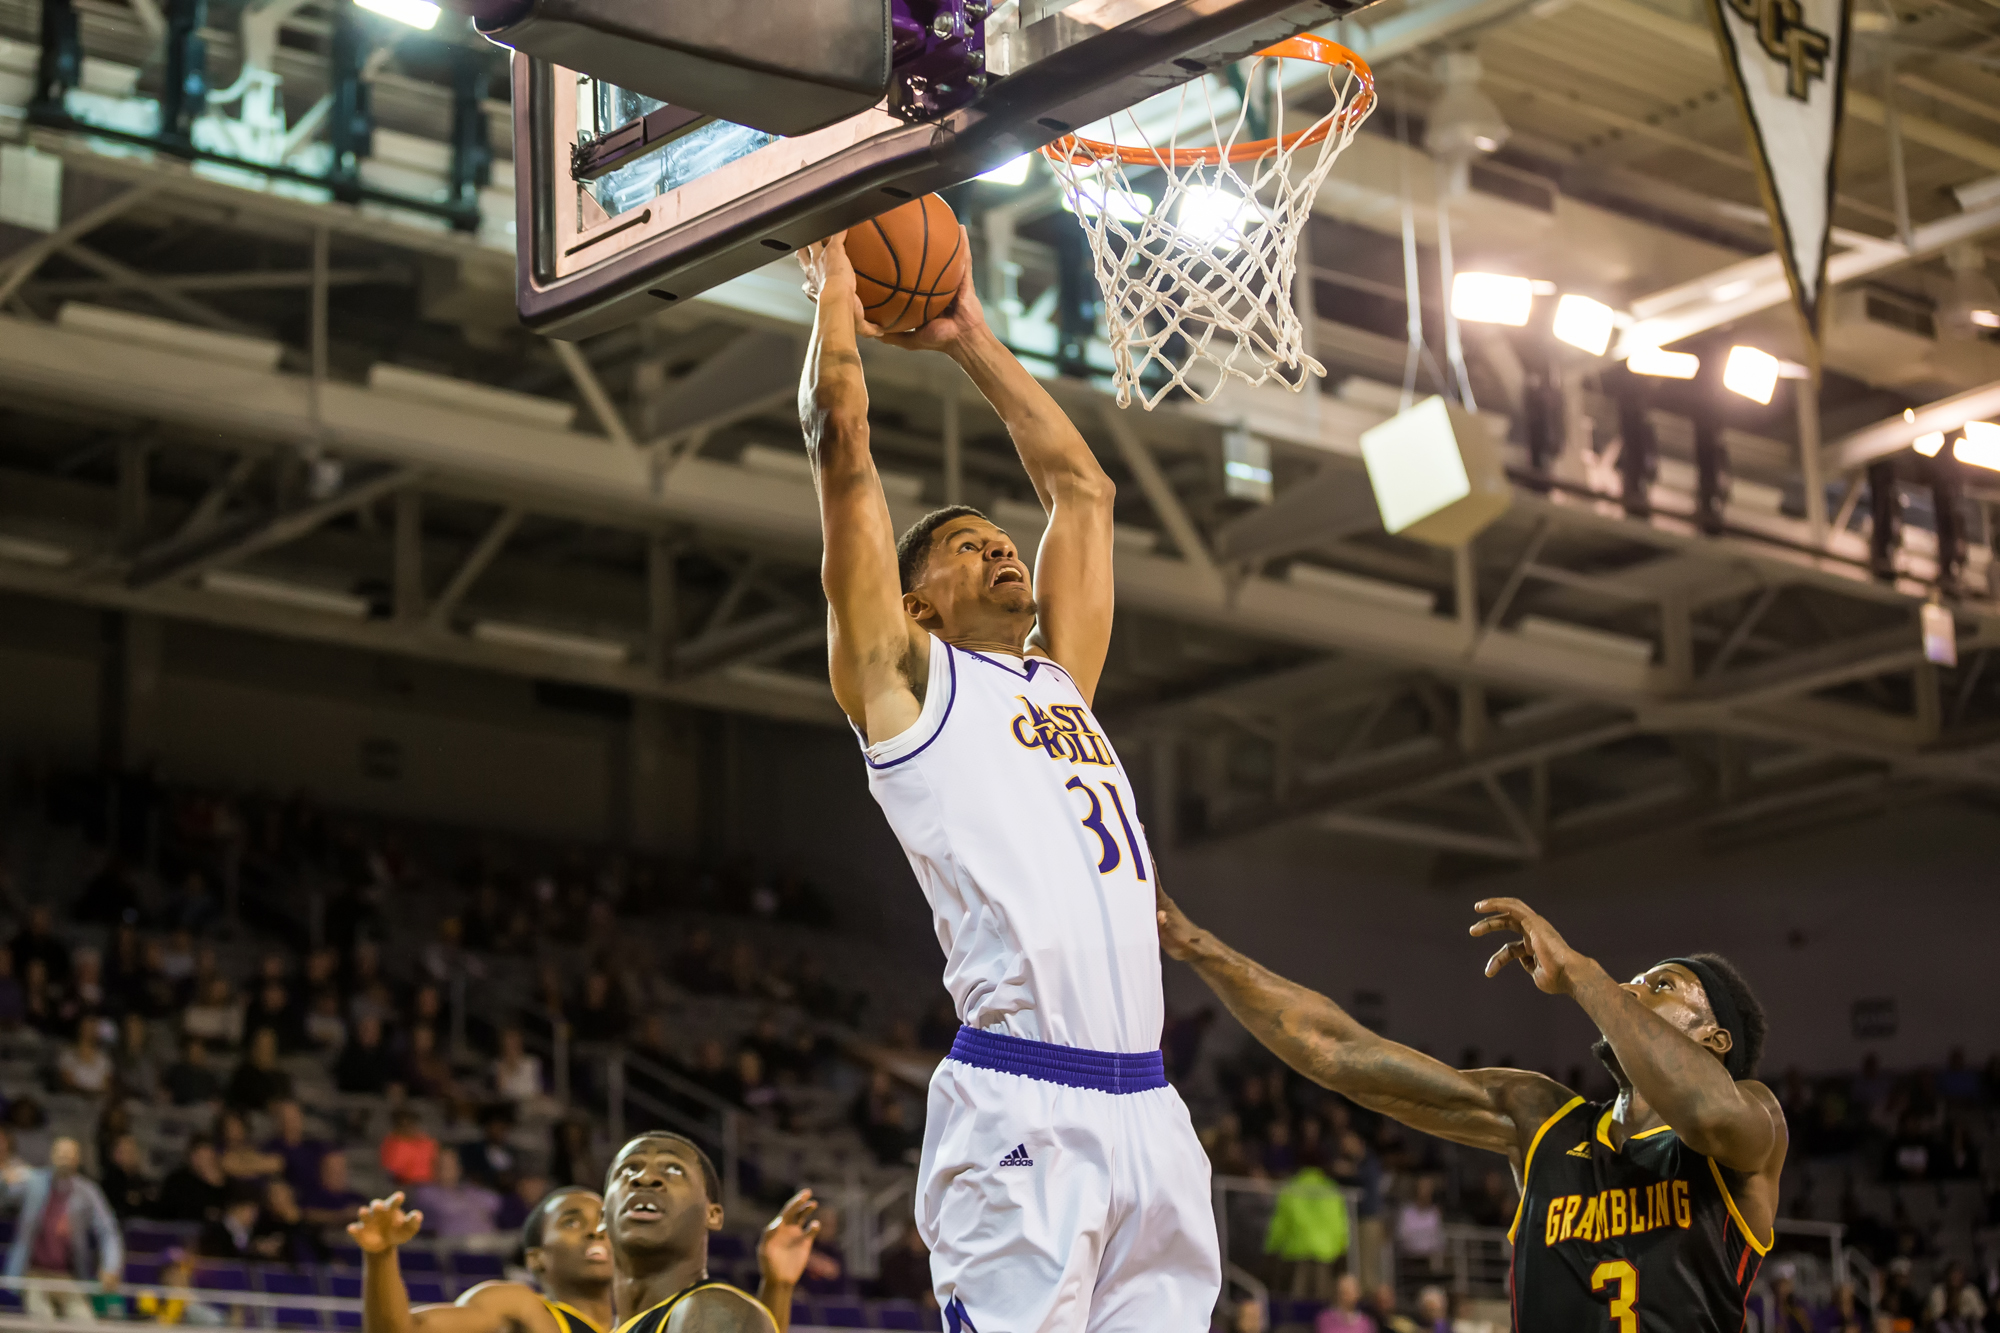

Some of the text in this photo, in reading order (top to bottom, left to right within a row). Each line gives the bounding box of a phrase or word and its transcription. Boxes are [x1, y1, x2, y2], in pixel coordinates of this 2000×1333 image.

[1065, 774, 1147, 882] 31
[999, 1158, 1034, 1167] adidas
[1545, 1180, 1692, 1247] GRAMBLING
[1591, 1258, 1640, 1333] 3
